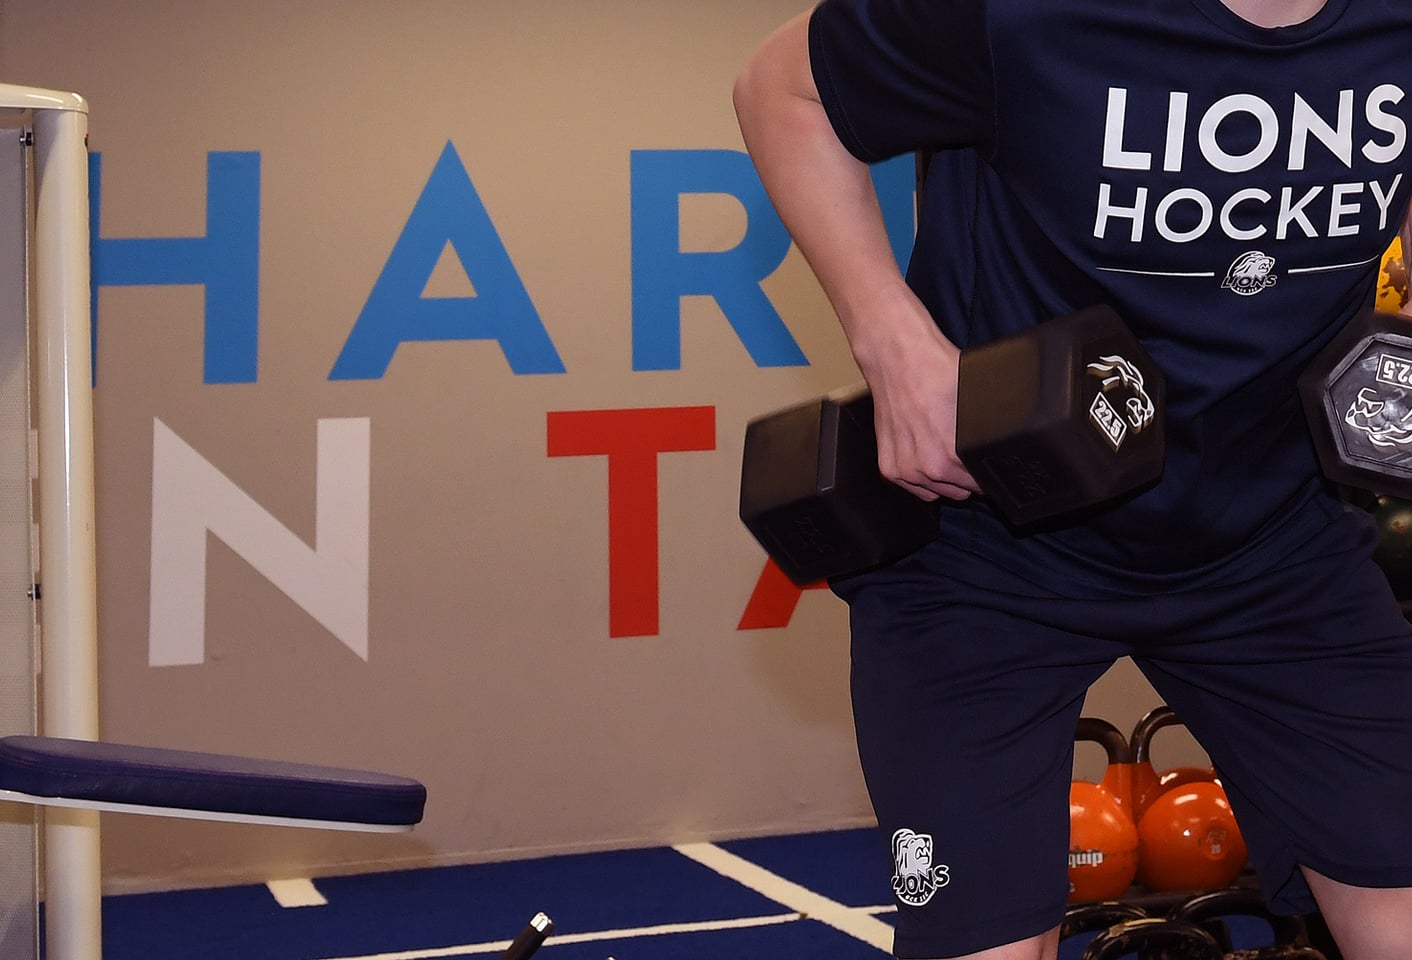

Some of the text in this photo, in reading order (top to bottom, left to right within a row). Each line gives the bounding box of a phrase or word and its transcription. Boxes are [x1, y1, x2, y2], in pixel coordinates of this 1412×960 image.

[1101, 83, 1407, 173] LIONS
[1093, 172, 1403, 243] HOCKEY
[87, 138, 917, 385] HAR
[1221, 275, 1278, 289] LIONS
[1094, 400, 1122, 438] 22.5
